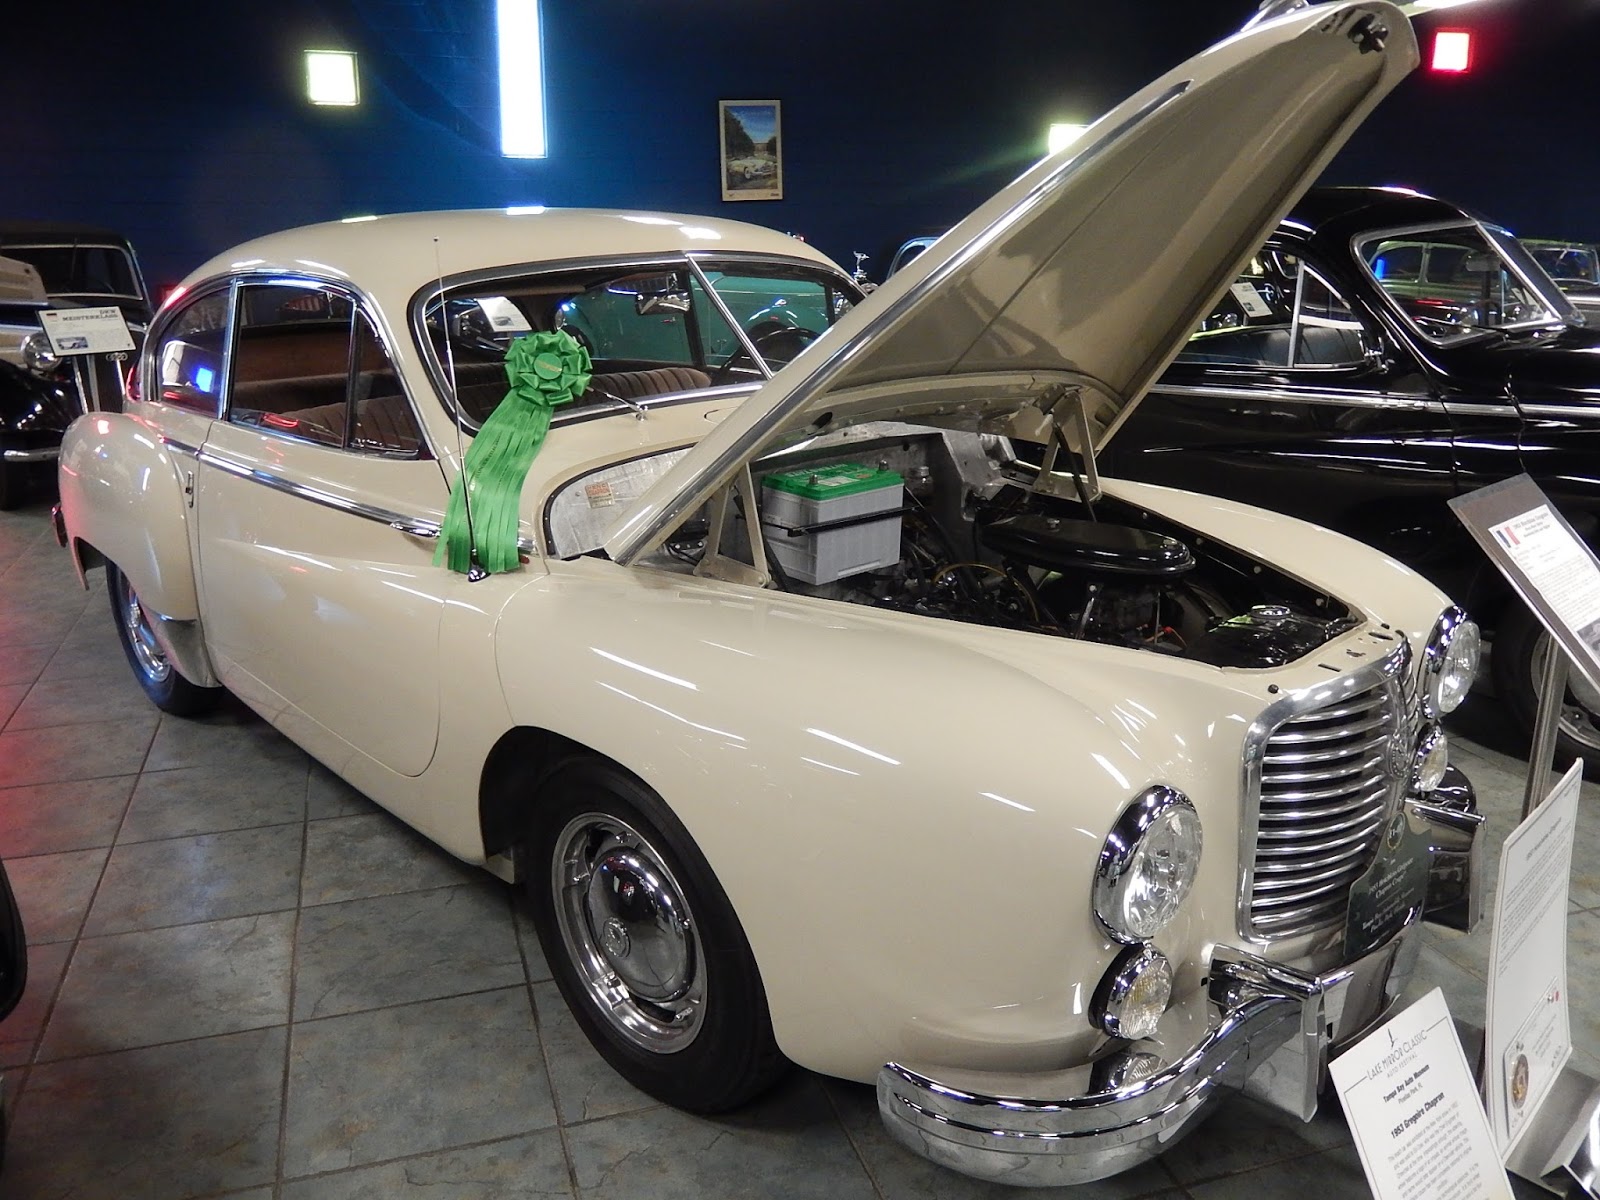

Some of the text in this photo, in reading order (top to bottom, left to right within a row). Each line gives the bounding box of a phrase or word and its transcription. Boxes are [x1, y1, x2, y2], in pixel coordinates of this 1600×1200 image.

[1367, 1029, 1428, 1081] LAKE MIRROR CLASSIC
[1383, 1064, 1430, 1104] Tampa Bay Auto Museum
[1390, 1091, 1445, 1139] 1953 Gregoire Chapron
